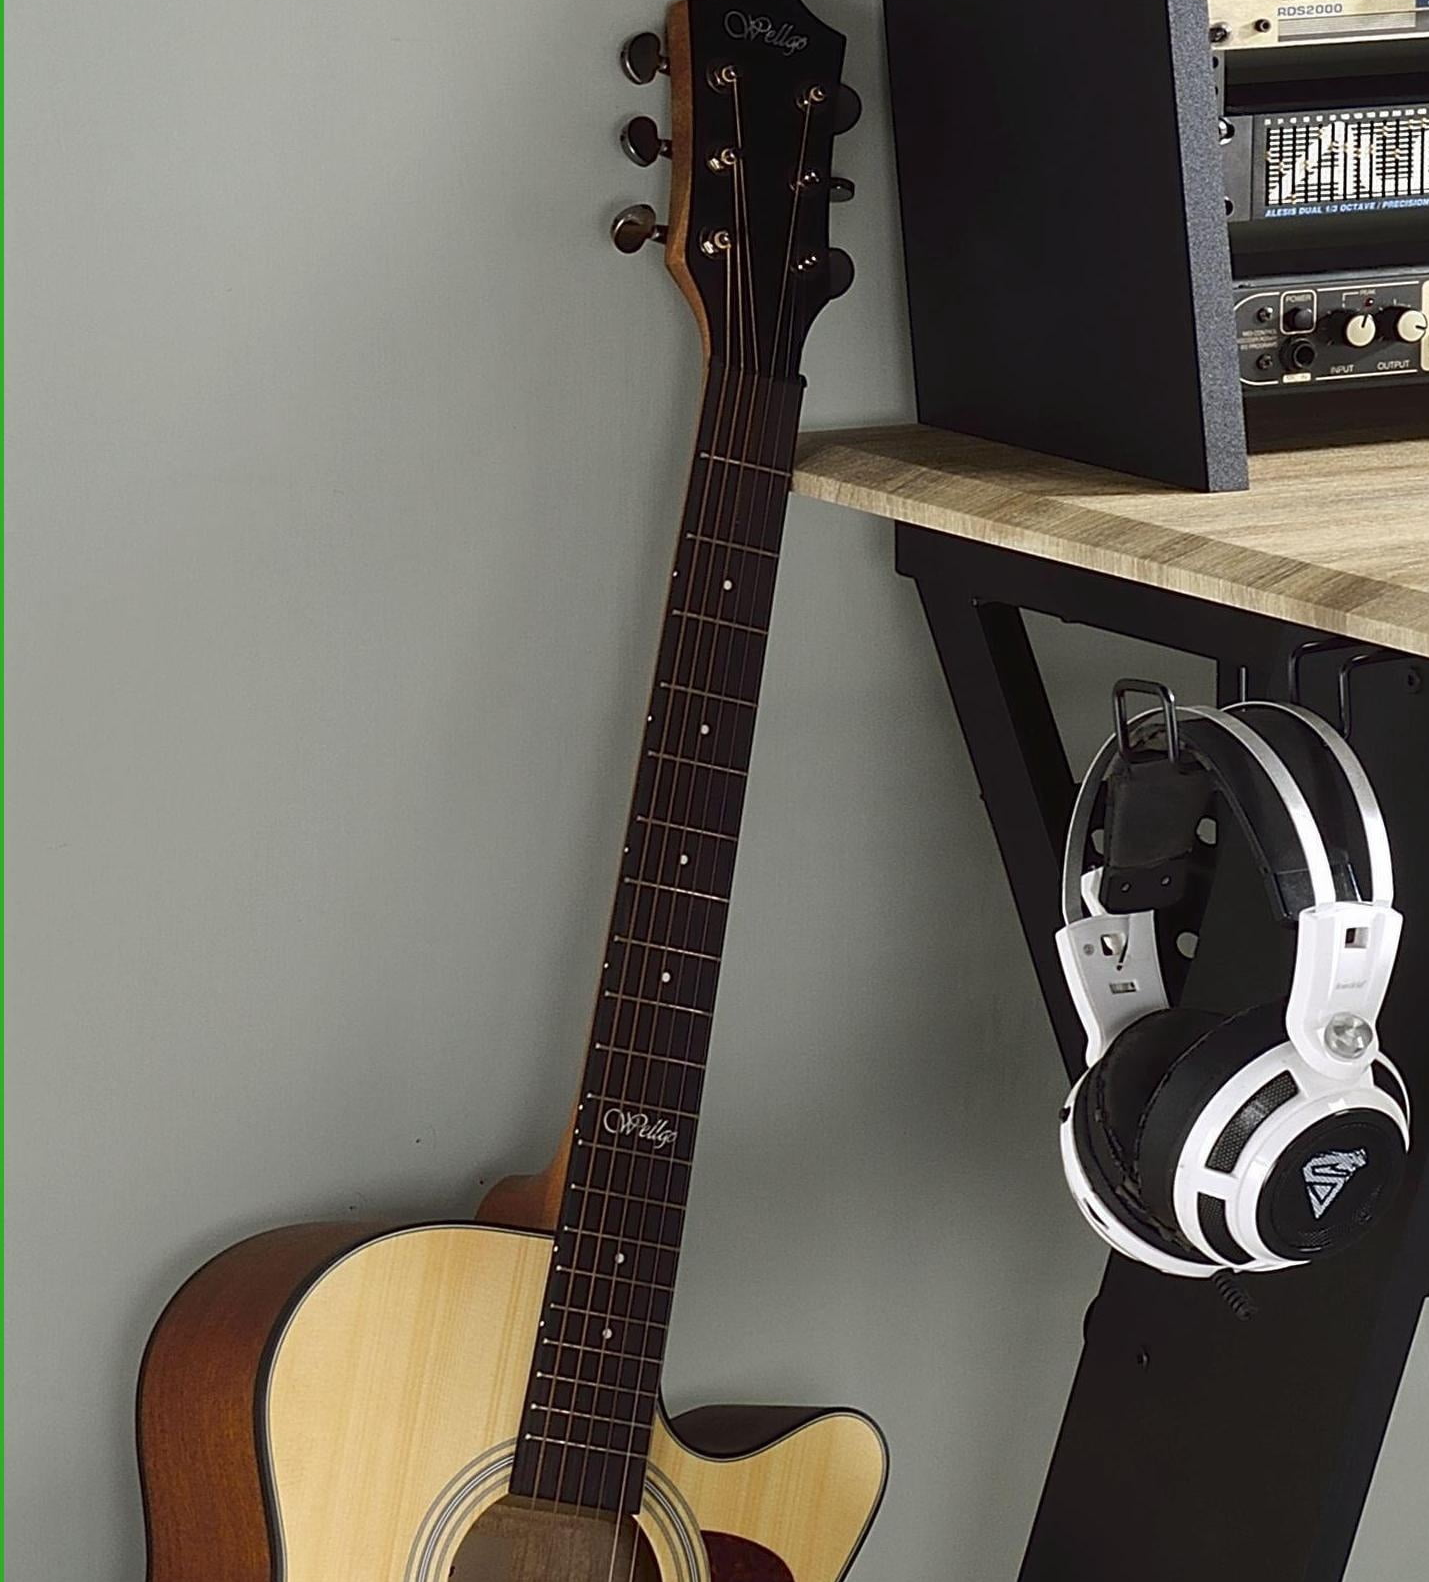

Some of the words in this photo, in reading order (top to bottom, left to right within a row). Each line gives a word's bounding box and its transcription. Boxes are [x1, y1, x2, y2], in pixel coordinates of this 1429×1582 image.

[1277, 3, 1343, 17] RDS2000
[1265, 207, 1297, 217] ALESIS
[1299, 205, 1322, 216] DUAL
[1340, 202, 1377, 212] OCTAVE
[1382, 198, 1429, 209] PRECISION
[1285, 294, 1312, 303] POWER
[1330, 364, 1354, 374] INPUT
[1377, 360, 1411, 371] OUTPUT
